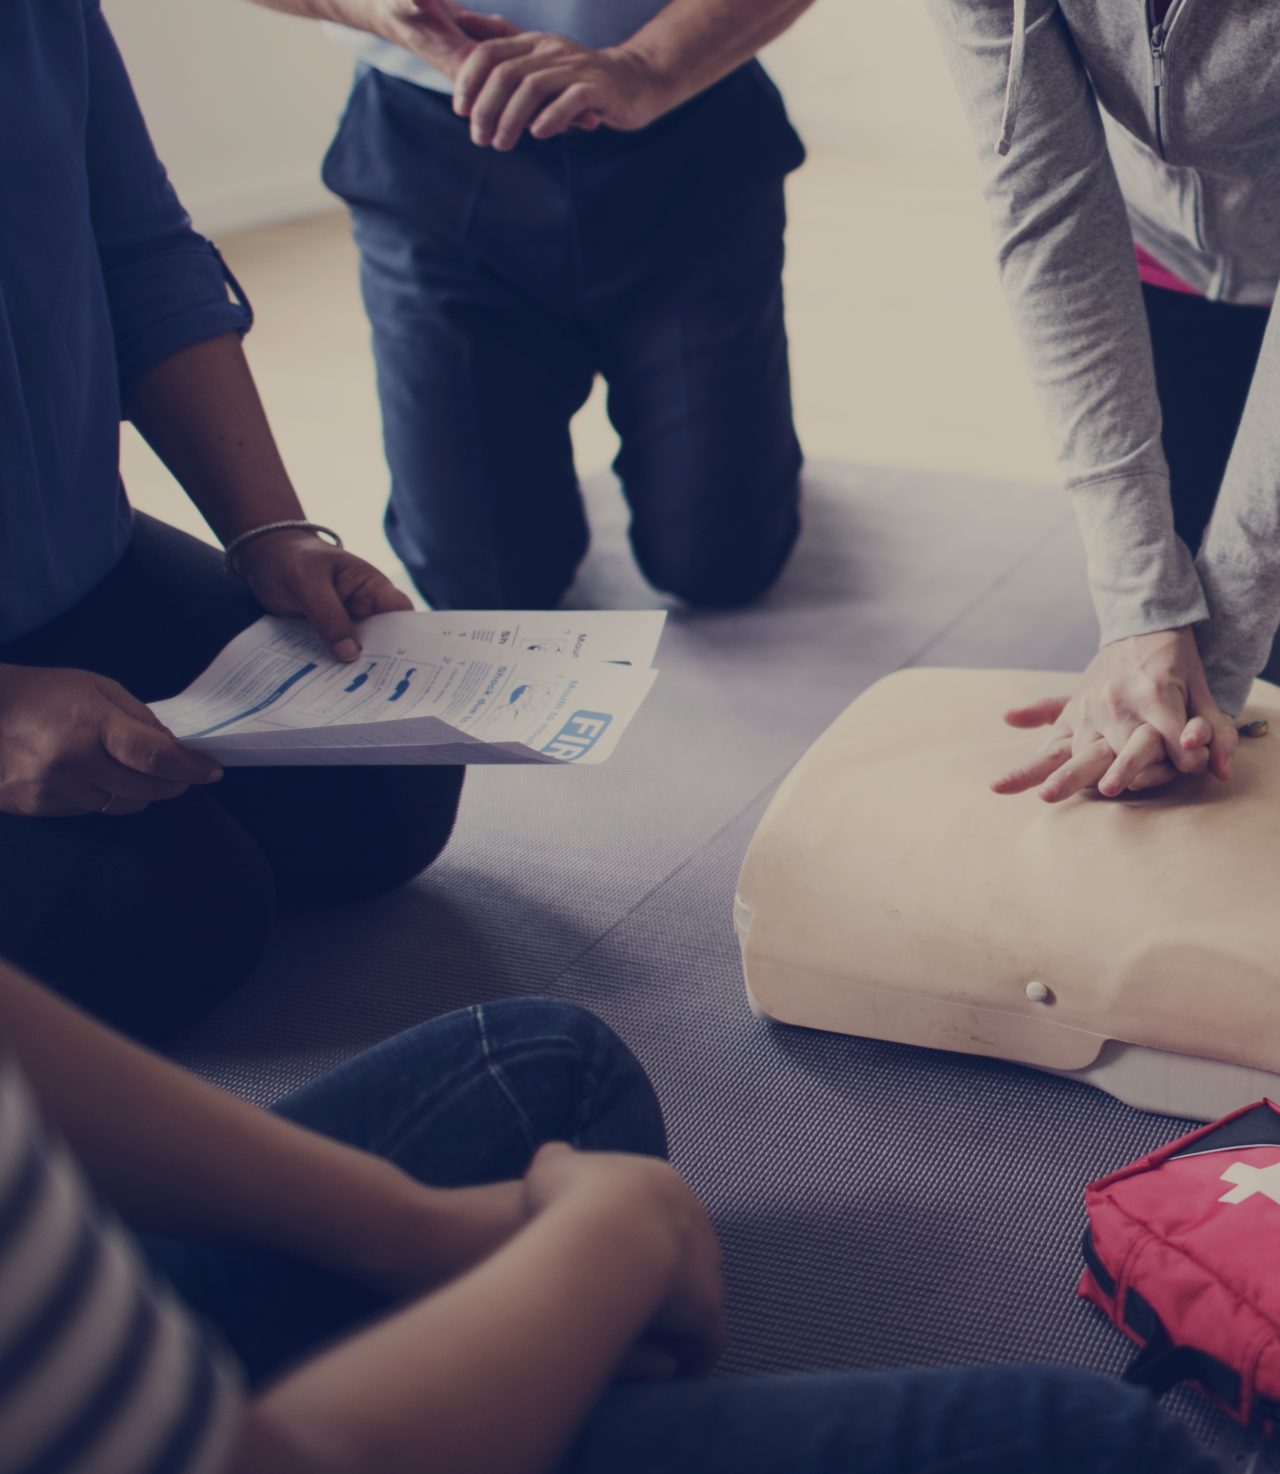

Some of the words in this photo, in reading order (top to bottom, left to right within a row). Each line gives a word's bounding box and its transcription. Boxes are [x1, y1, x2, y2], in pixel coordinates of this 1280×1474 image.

[485, 665, 508, 695] Shock
[555, 679, 579, 711] Mouth
[470, 697, 486, 715] due
